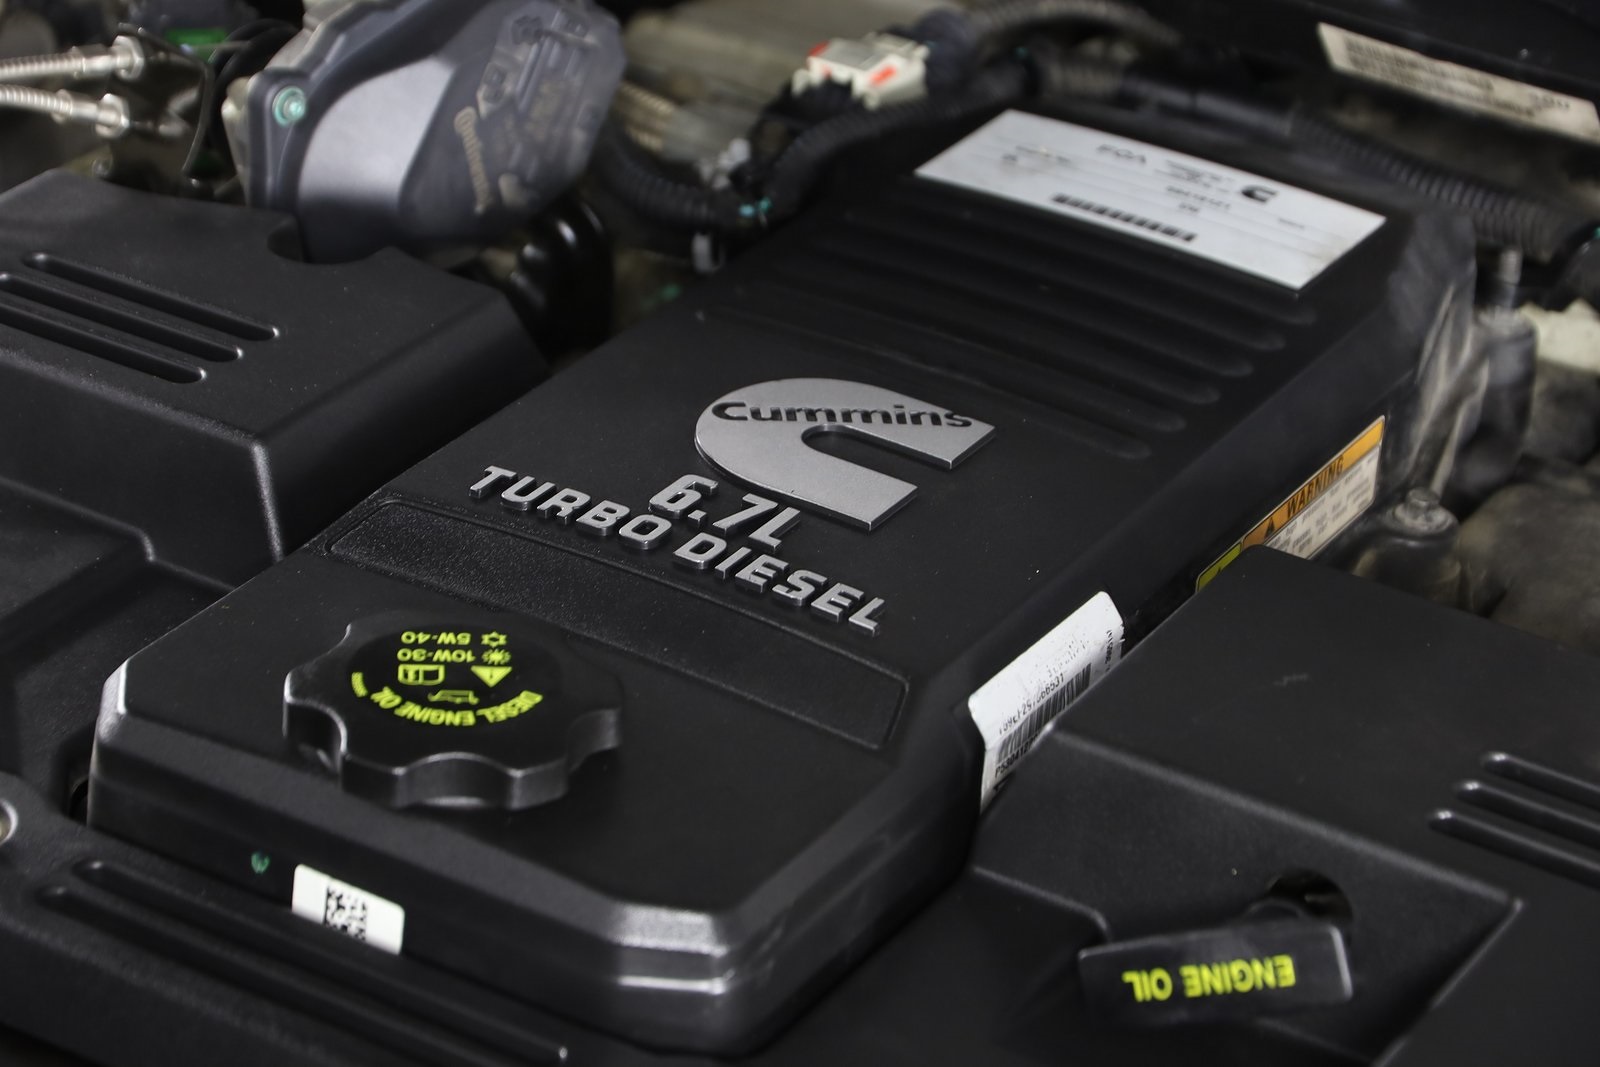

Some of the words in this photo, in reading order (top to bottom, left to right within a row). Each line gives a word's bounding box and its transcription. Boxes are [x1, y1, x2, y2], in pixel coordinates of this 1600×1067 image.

[711, 400, 974, 429] Cummins
[1286, 454, 1344, 519] WARNING
[648, 473, 801, 553] 6.7L
[468, 464, 673, 550] TURBO
[672, 531, 885, 637] DIESEL
[396, 648, 476, 663] 10W-30
[400, 631, 472, 646] 5W-40
[370, 686, 402, 709] OIL
[393, 700, 476, 727] ENGINE
[475, 689, 544, 724] DIESEL
[1121, 967, 1174, 1003] OIL
[1179, 954, 1297, 998] ENGINE
